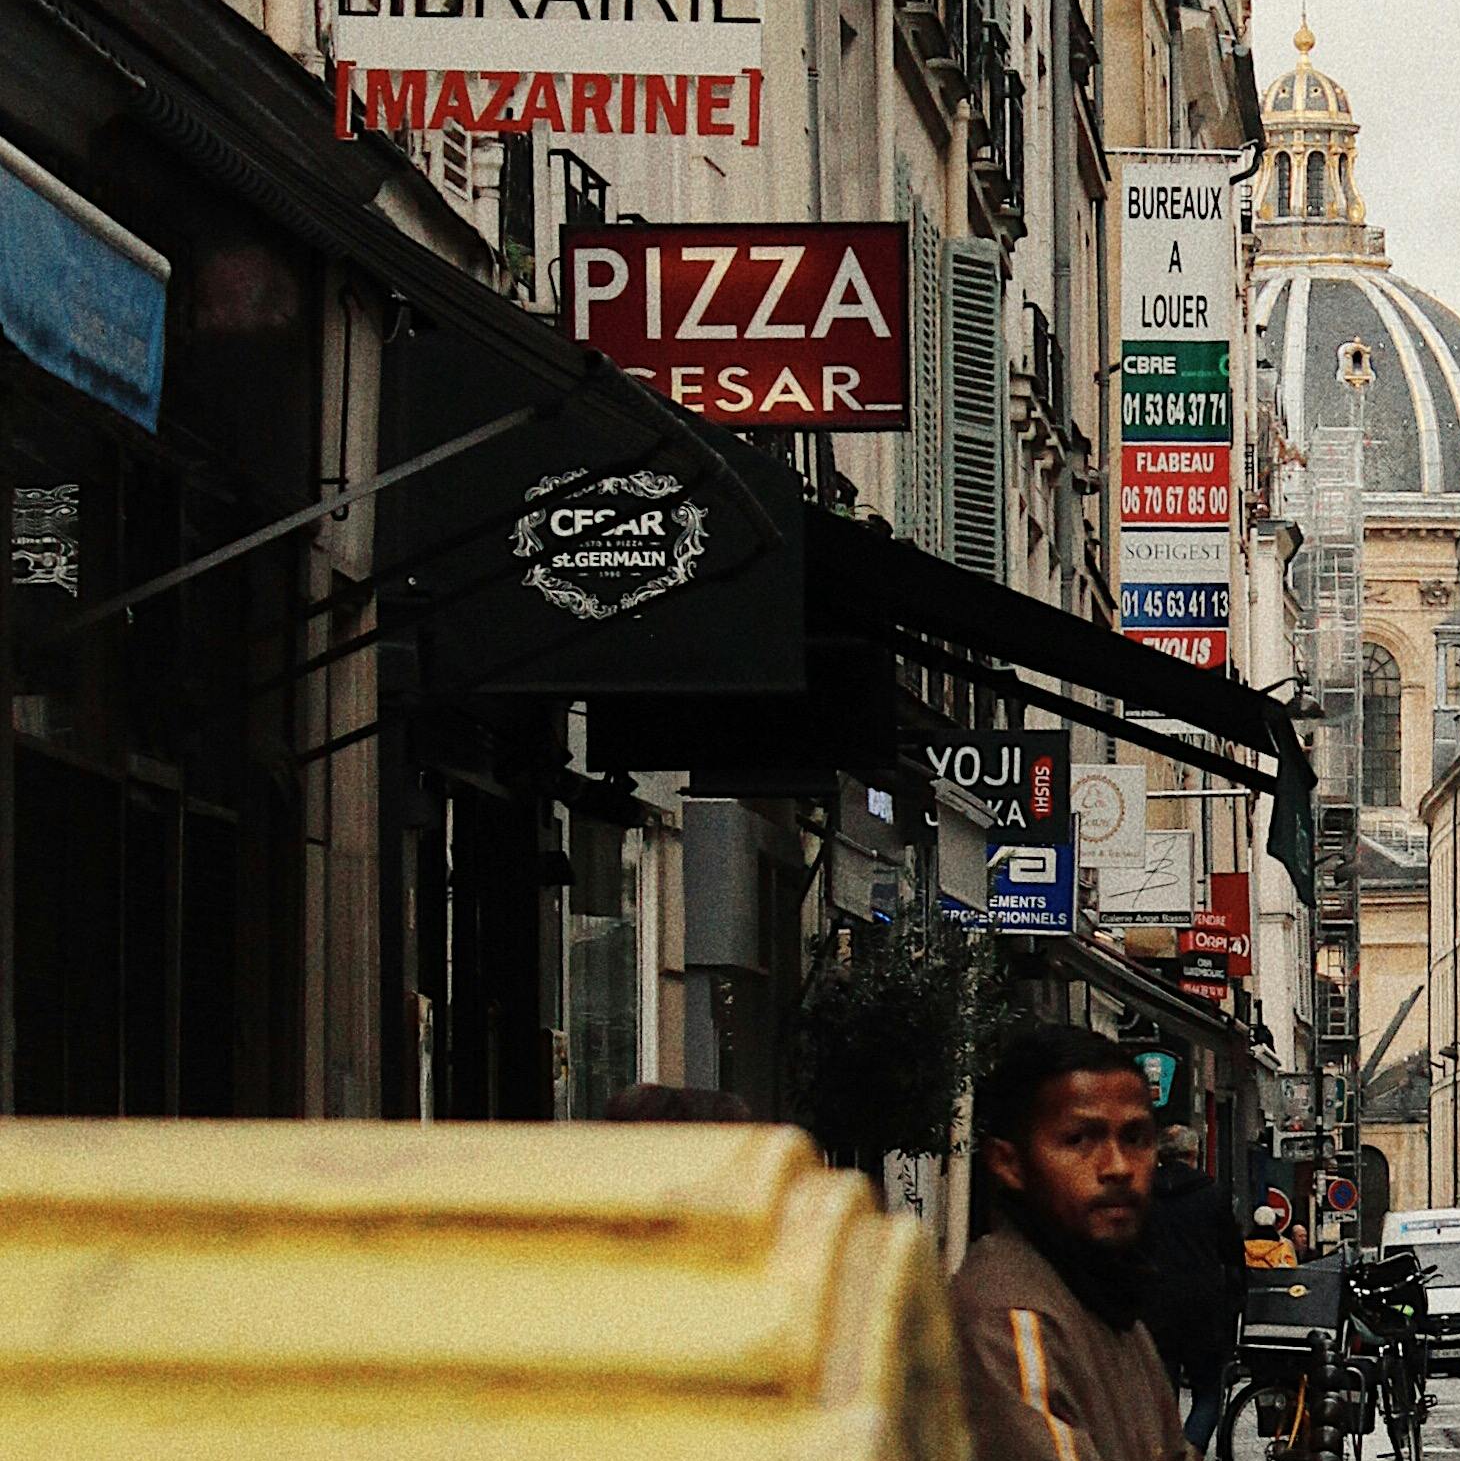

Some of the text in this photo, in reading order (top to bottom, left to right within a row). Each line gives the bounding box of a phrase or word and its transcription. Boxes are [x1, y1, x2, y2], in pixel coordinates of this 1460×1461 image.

[1127, 185, 1222, 220] BUREAUX
[1167, 240, 1183, 274] A
[572, 245, 893, 340] PIZZA
[1141, 294, 1208, 329] LOUER
[1122, 355, 1177, 375] CBRE
[1123, 392, 1226, 427] 01 53 64 37 71
[1136, 451, 1215, 474] FLABEAU
[1121, 485, 1228, 515] 06 70 67 85 00
[1124, 542, 1224, 561] SOFIGEST
[1121, 590, 1229, 618] 01 45 63 41 13
[925, 745, 1021, 787] YOJI
[1034, 765, 1050, 813] SUSHI
[1101, 913, 1133, 923] Galerie
